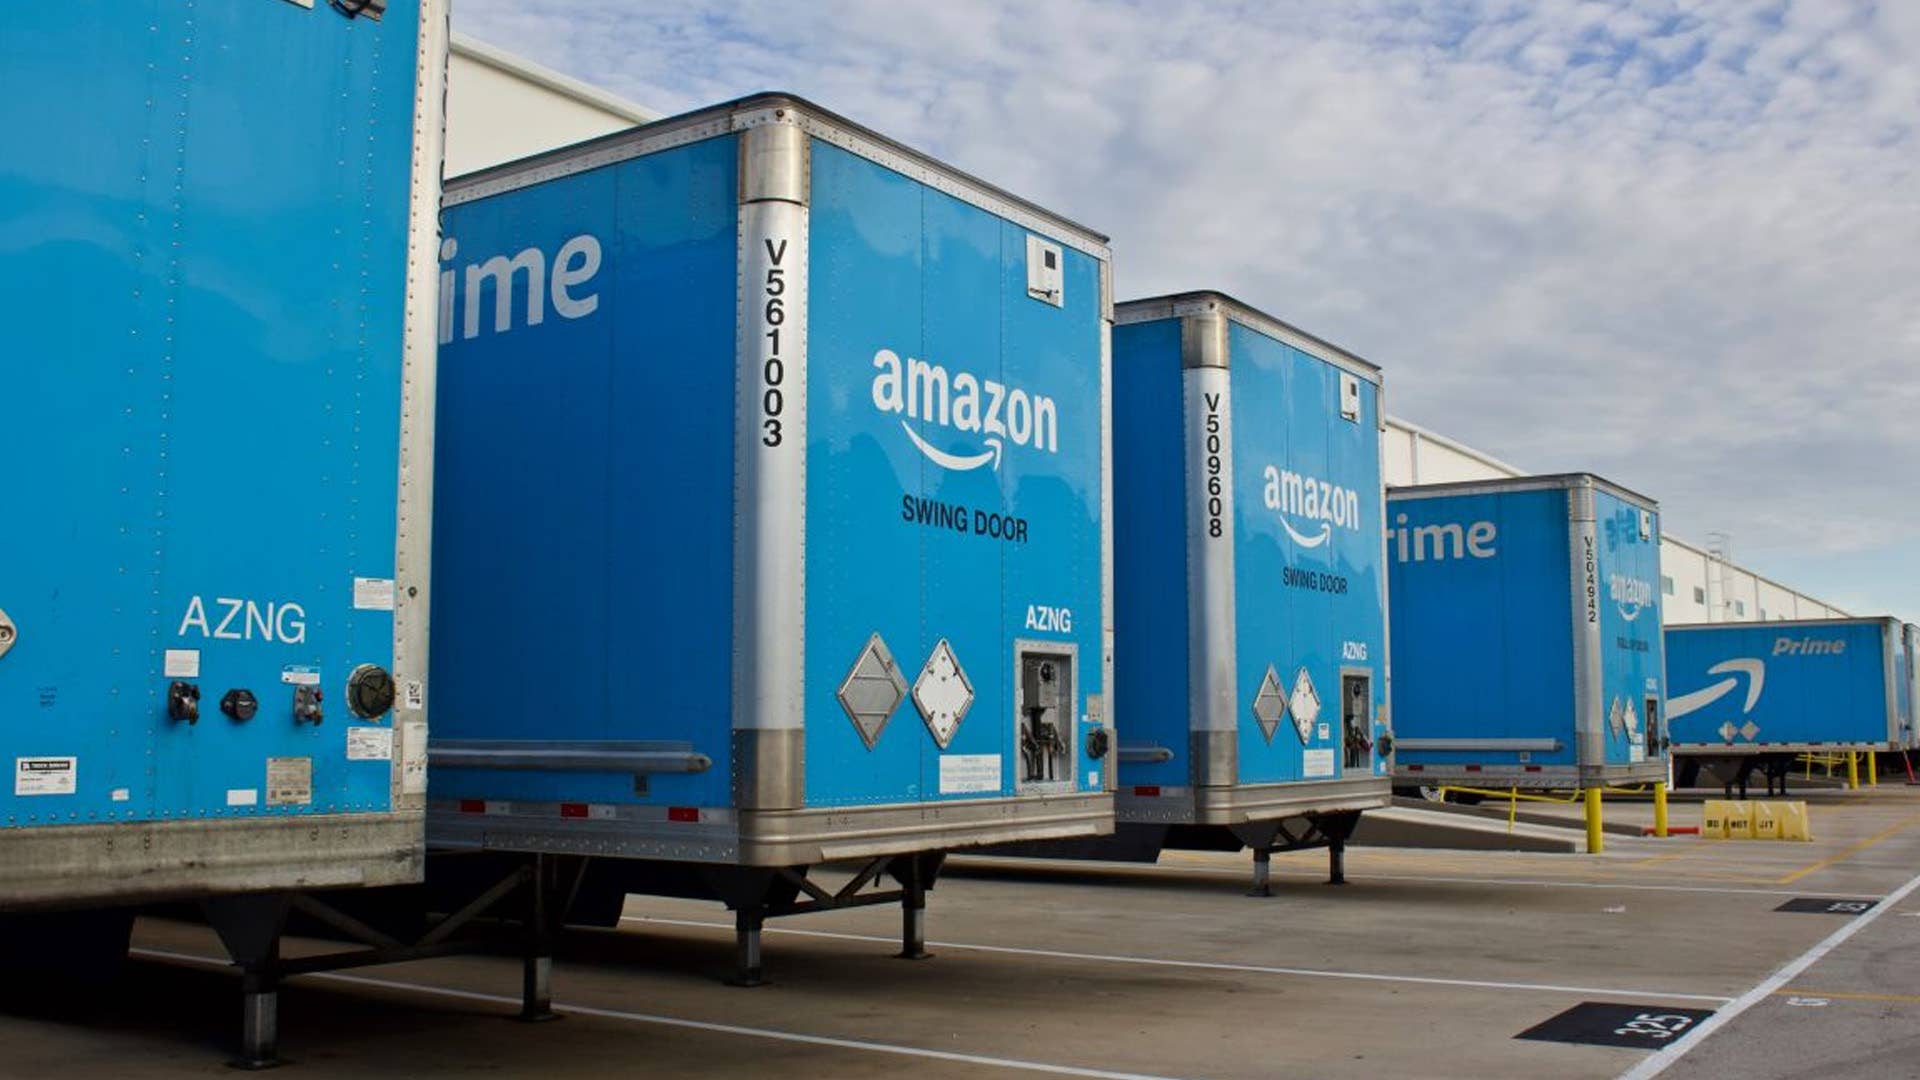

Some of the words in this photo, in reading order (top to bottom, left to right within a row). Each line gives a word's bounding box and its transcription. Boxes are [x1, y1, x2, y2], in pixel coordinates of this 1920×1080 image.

[439, 234, 602, 344] ime
[763, 238, 787, 447] V561003
[871, 349, 1058, 453] amazon
[1204, 393, 1222, 538] V509608
[902, 494, 967, 532] SWING
[974, 510, 1028, 543] DOOR
[1263, 465, 1359, 530] amazon
[1387, 513, 1497, 562] ime
[1282, 566, 1318, 589] SWING
[1320, 572, 1348, 594] DOOR
[1610, 574, 1652, 607] amazon
[178, 594, 307, 645] AZNG
[1025, 604, 1072, 633] AZNG
[1342, 641, 1367, 660] AZNG
[1772, 636, 1847, 657] Prime
[1613, 1013, 1693, 1039] 325
